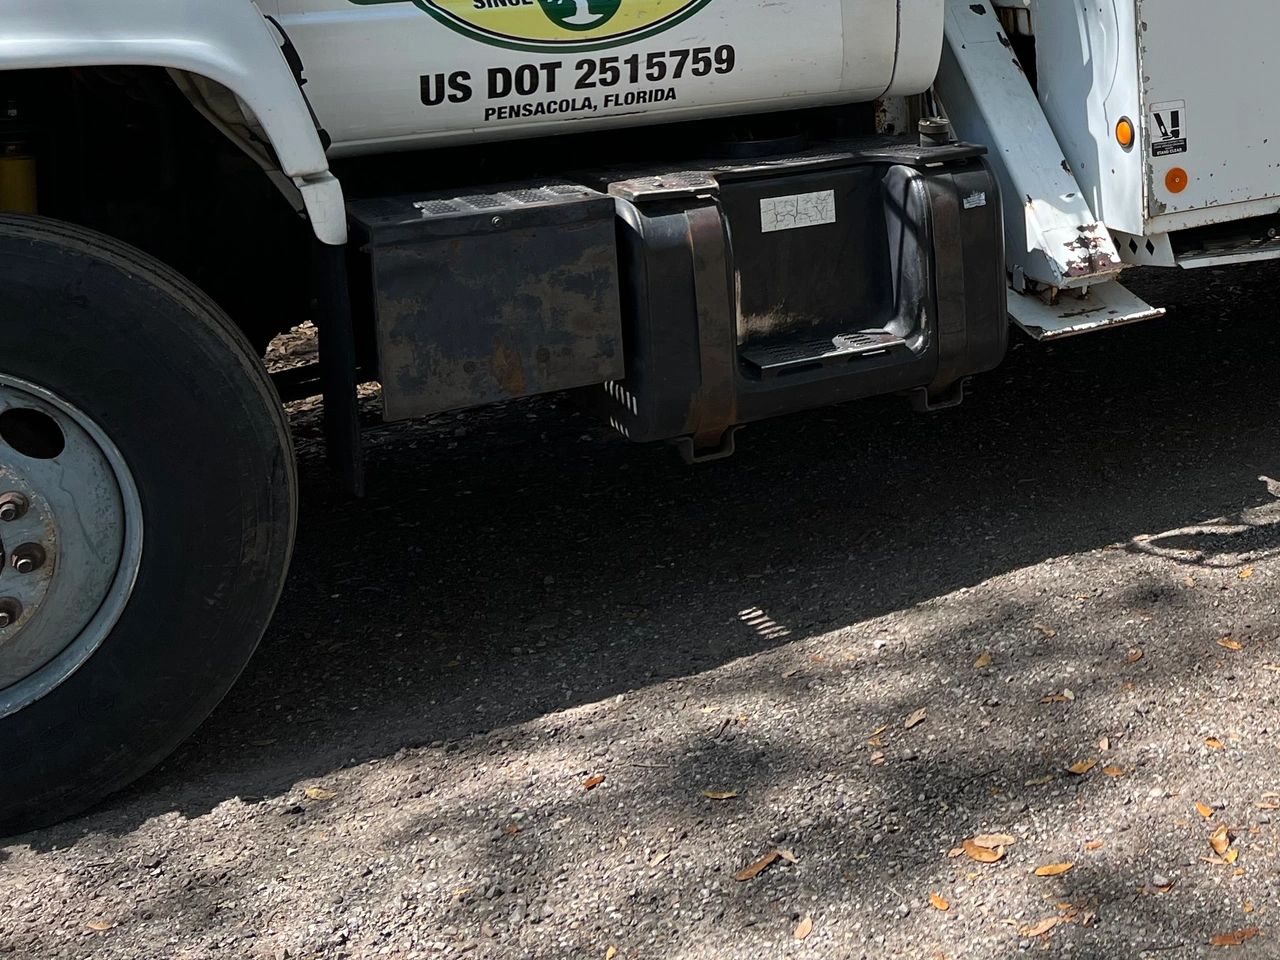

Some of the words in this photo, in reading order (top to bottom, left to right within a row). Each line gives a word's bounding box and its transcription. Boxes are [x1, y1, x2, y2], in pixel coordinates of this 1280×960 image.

[419, 70, 473, 107] US
[487, 61, 563, 99] DOT
[574, 43, 736, 90] 2515759
[484, 96, 598, 121] PENSACOLA,
[603, 87, 677, 109] FLORIDA
